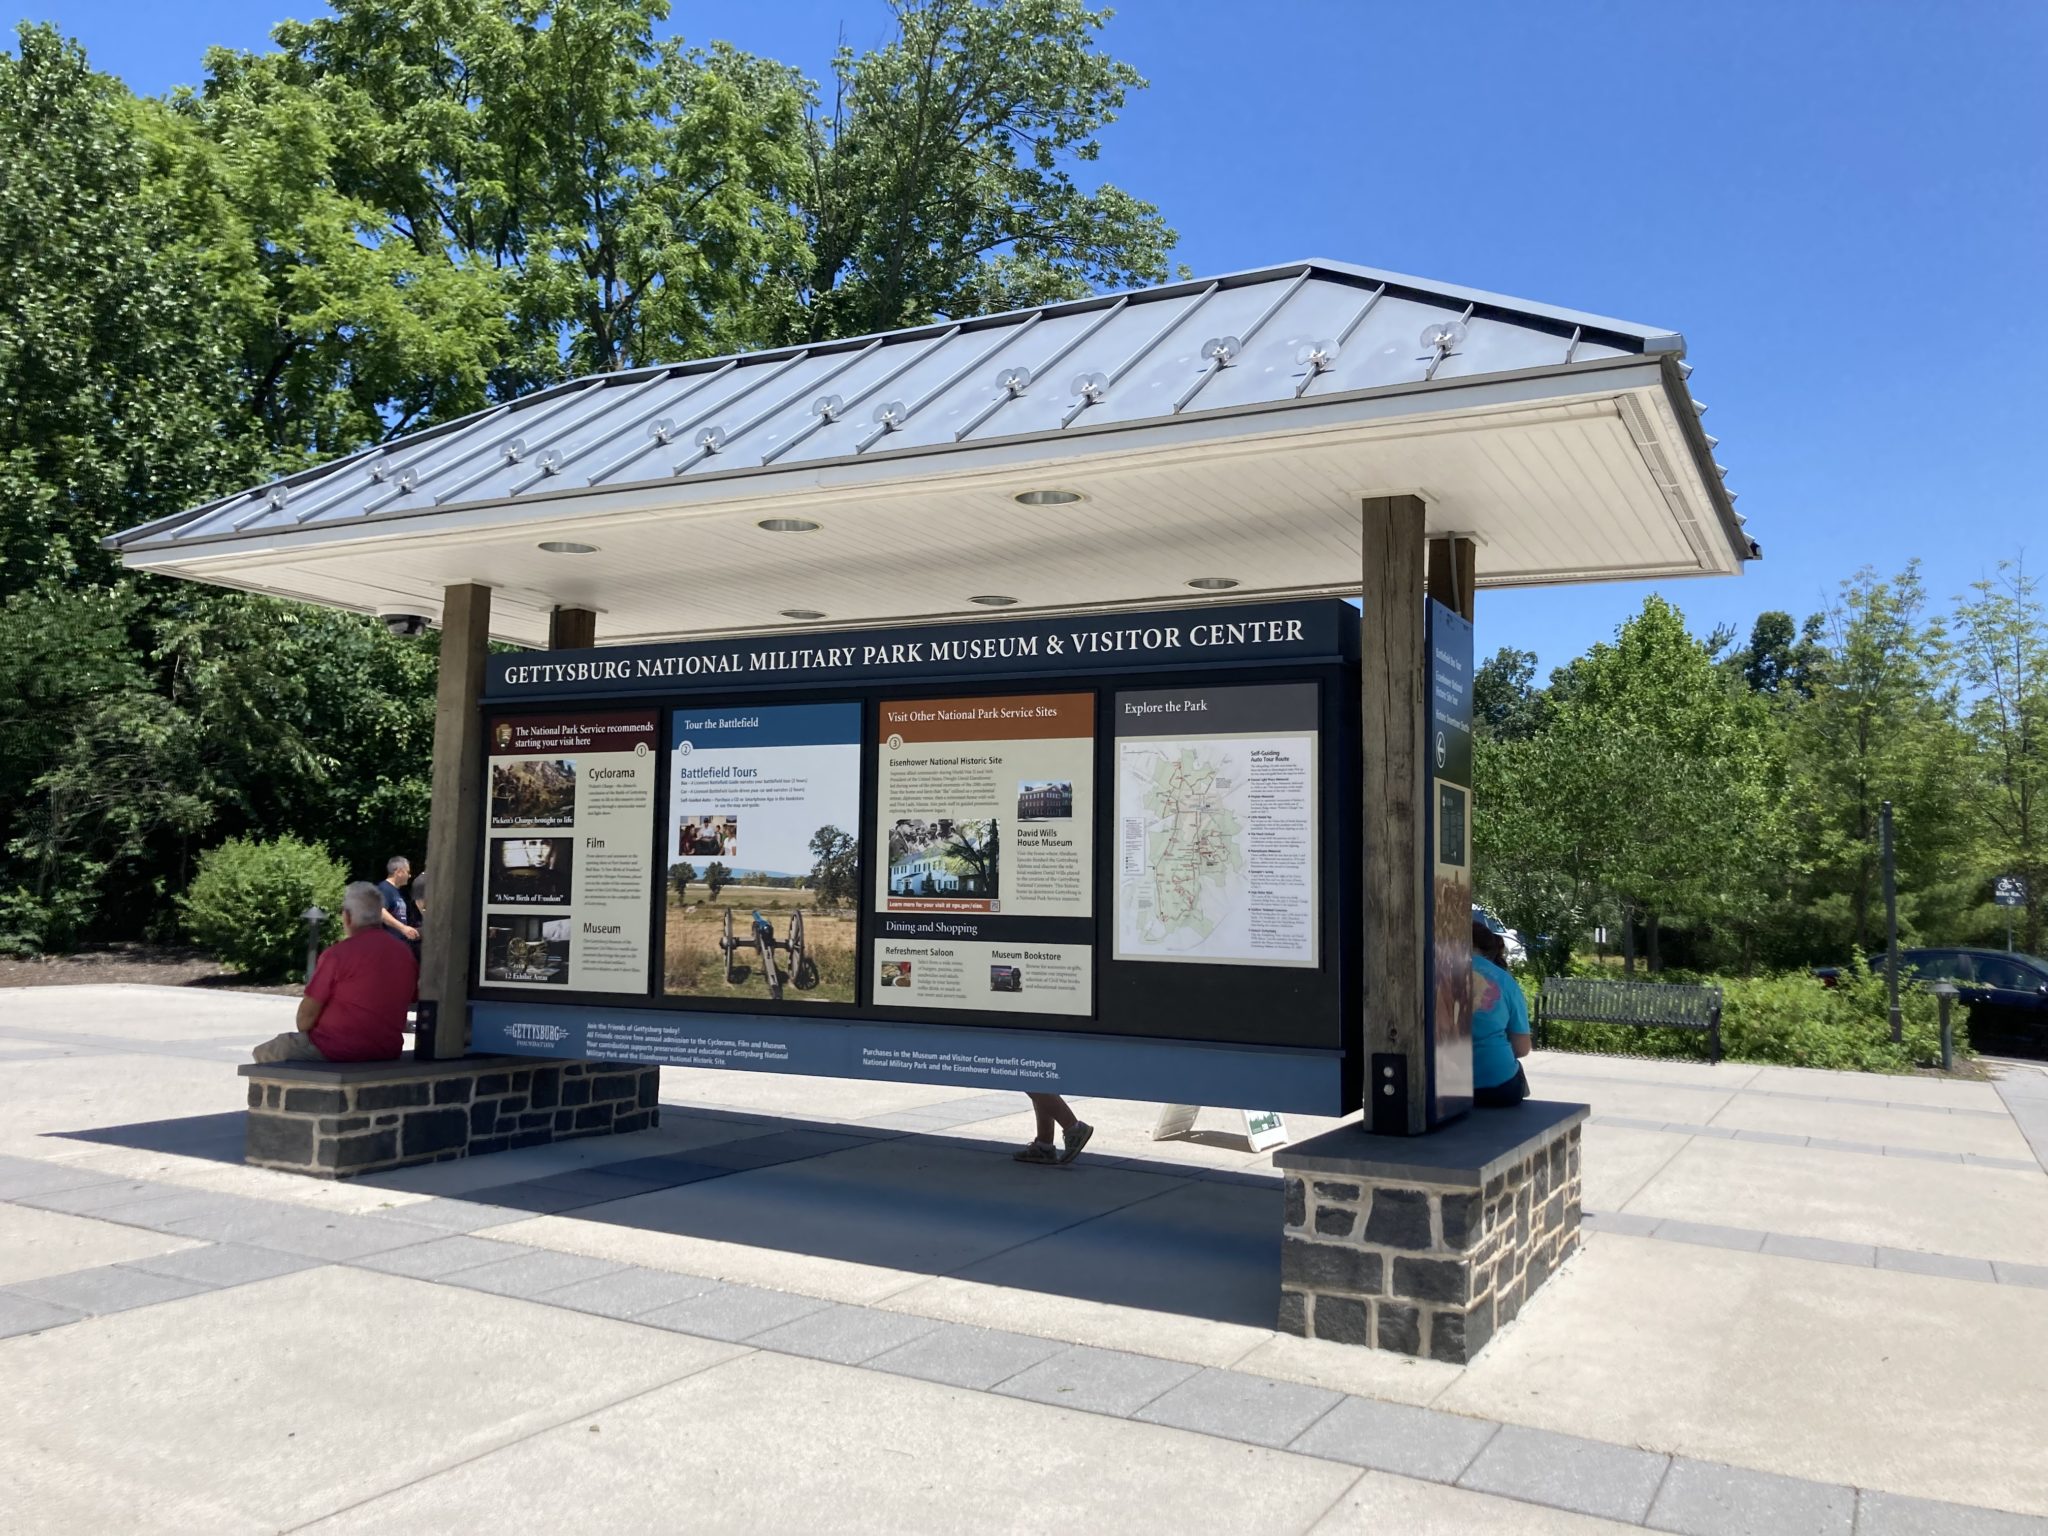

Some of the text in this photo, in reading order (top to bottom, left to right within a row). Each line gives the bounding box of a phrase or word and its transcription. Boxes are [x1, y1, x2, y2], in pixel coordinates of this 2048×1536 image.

[504, 619, 1304, 684] GETTYSBURG NATIONAL MILITARY PARK MUSEUM & VISITOR CENTER
[888, 706, 1058, 722] Visit Other National Park Service Sites
[1125, 700, 1208, 716] Explore the Park
[516, 722, 654, 736] The National Park Service recommends
[684, 717, 759, 729] Tour the Battlefield
[515, 736, 591, 749] starting your visit here
[889, 756, 1003, 767] Eisenhower National Historic Site
[589, 768, 635, 782] Cyclorama
[681, 766, 758, 778] Battlefield Tours
[1017, 829, 1057, 837] David Wills
[587, 838, 605, 848] Film
[1017, 839, 1073, 847] House Museum
[584, 922, 621, 934] Museum
[886, 921, 978, 936] Dining and Shopping
[886, 947, 954, 957] Refreshment Saloon
[992, 951, 1061, 961] Museum Bookstore
[512, 1023, 559, 1041] GETTYSBURG
[608, 1023, 626, 1031] Friends
[634, 1025, 662, 1034] Gettysburg
[639, 1053, 669, 1061] Eisenhower
[669, 1055, 692, 1063] National
[653, 1045, 687, 1053] preservation
[698, 1048, 725, 1056] education
[733, 1049, 763, 1059] Gettysburg
[863, 1048, 1057, 1070] Purchases in the Museum and Visitor Center benefit Gettysburg
[863, 1058, 1061, 1080] National Military Park and the Eisenhower National Historic Site.
